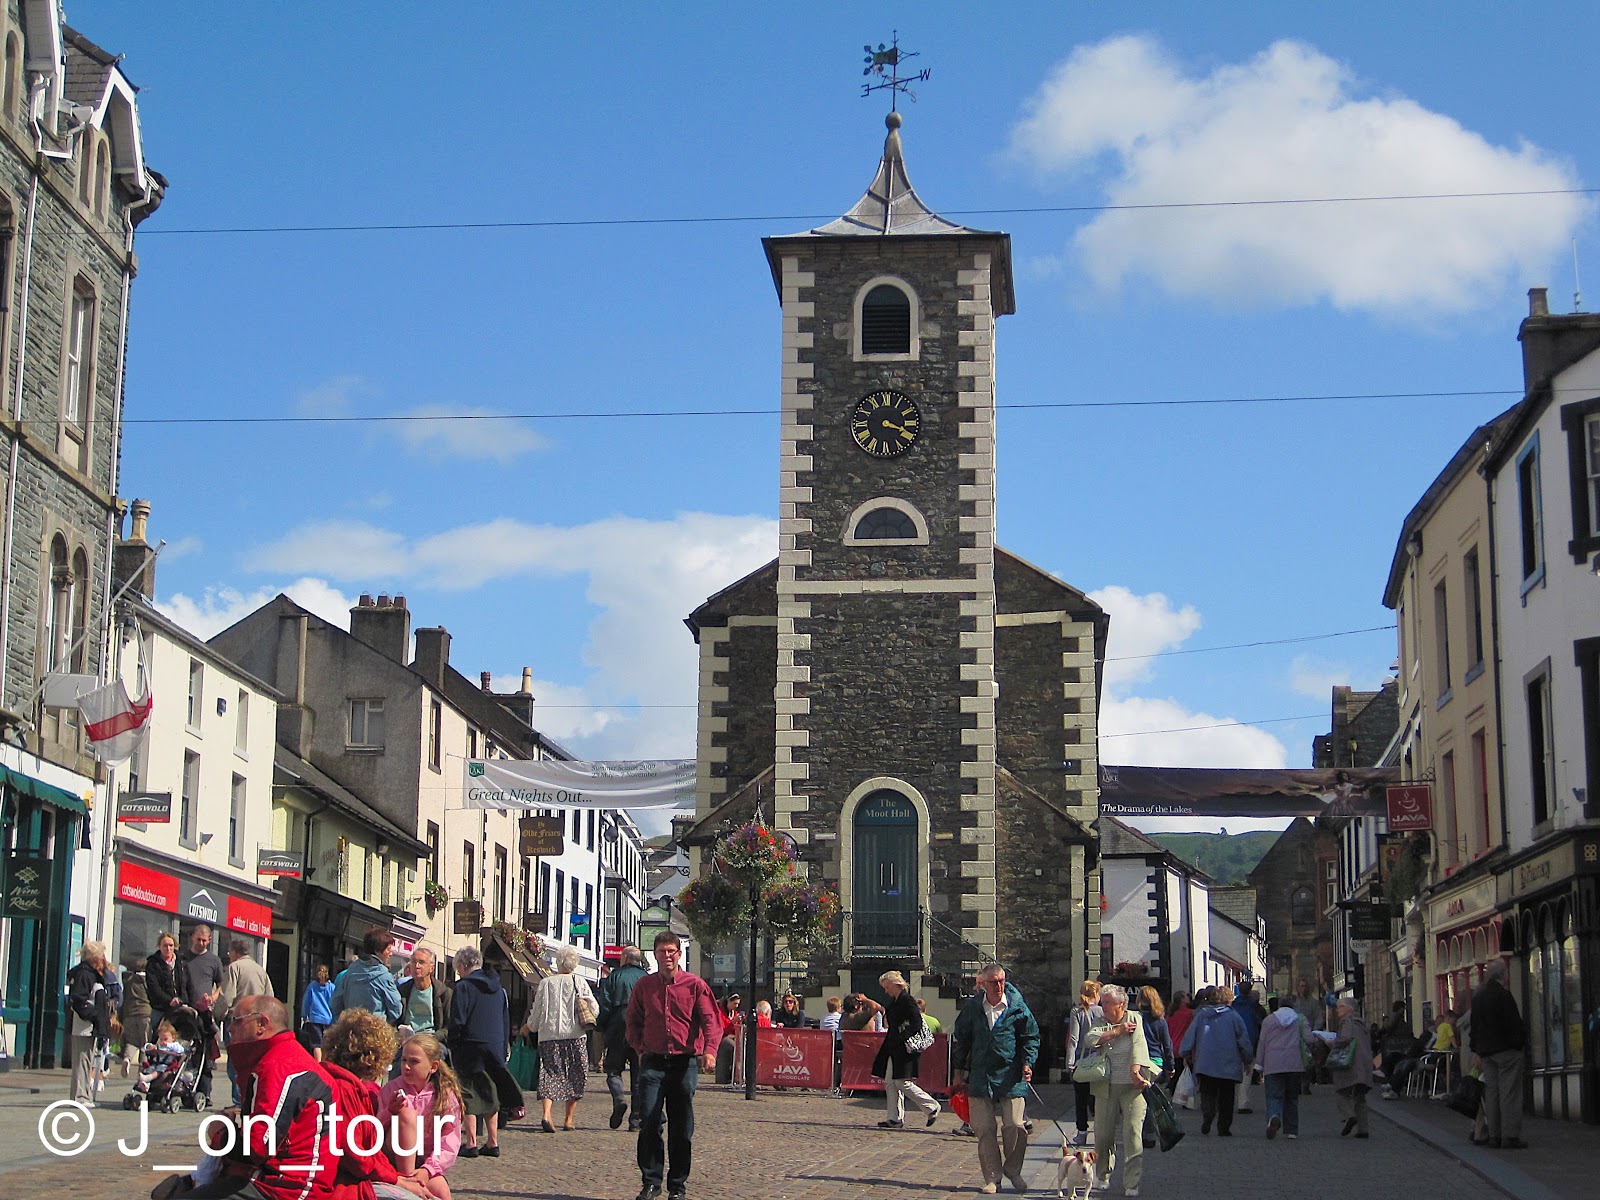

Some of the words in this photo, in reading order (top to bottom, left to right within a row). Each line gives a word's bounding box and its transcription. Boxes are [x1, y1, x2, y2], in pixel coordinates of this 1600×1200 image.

[882, 394, 890, 406] XII
[469, 788, 506, 801] Great
[509, 789, 553, 804] Nights
[557, 790, 592, 803] Out...
[880, 799, 896, 807] The
[1102, 804, 1117, 812] The
[1146, 805, 1154, 814] of
[10, 886, 40, 896] Wine
[121, 884, 166, 906] cotswoldoutdoor.com
[9, 897, 44, 910] Rack
[188, 903, 218, 922] COTSWOLD
[232, 916, 246, 928] outdoor
[249, 921, 258, 931] action
[262, 925, 271, 935] travel
[774, 1065, 810, 1075] JAVA
